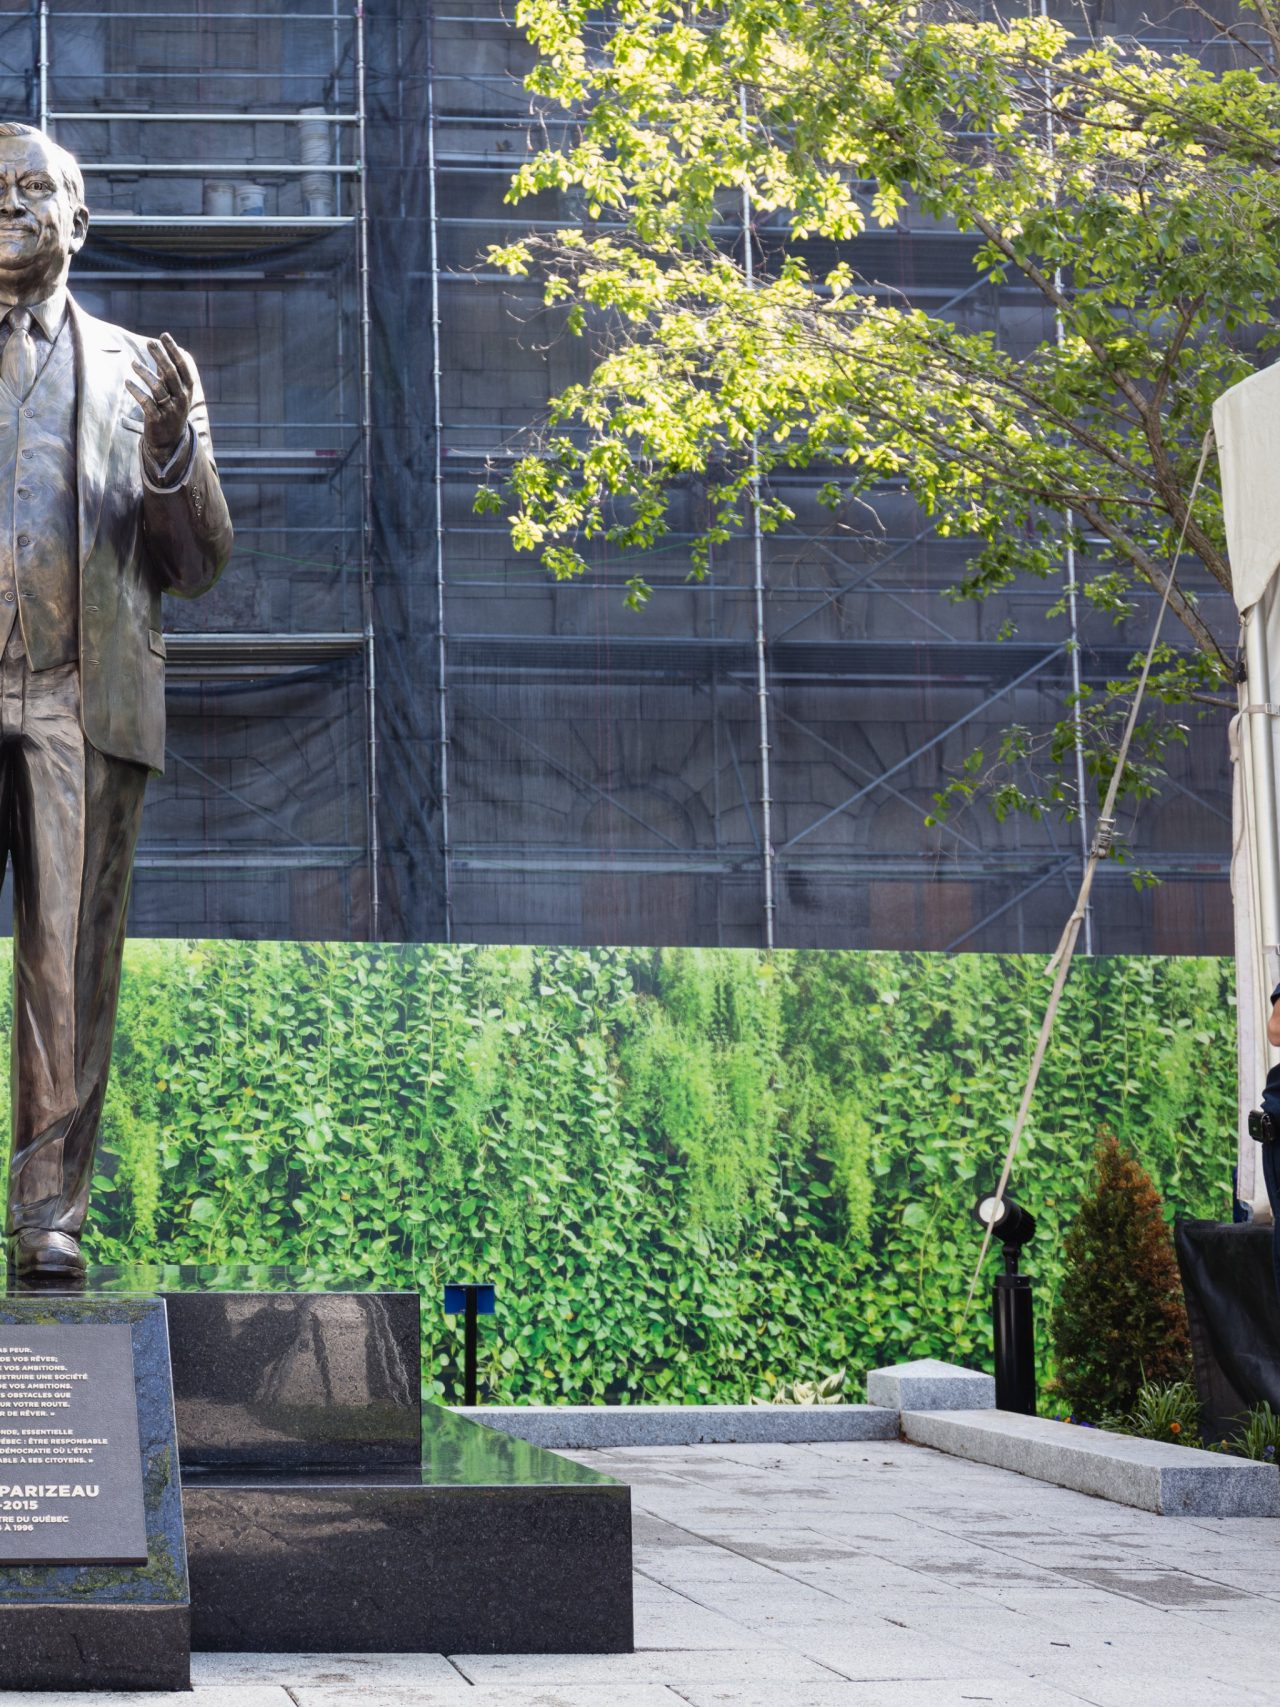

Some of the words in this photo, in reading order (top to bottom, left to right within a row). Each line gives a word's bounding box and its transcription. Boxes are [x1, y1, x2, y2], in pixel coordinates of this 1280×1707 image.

[54, 1372, 88, 1380] SOCIÉTÉ
[19, 1409, 49, 1417] RÊVER.
[28, 1437, 49, 1445] ÊTRE
[0, 1446, 51, 1454] DÉMOCRATIE
[52, 1446, 66, 1454] OÙ
[66, 1446, 93, 1454] L'ÉTAT
[16, 1515, 30, 1523] DU
[31, 1514, 70, 1523] QUÉBEC
[3, 1523, 12, 1532] À
[12, 1524, 34, 1532] 1996
